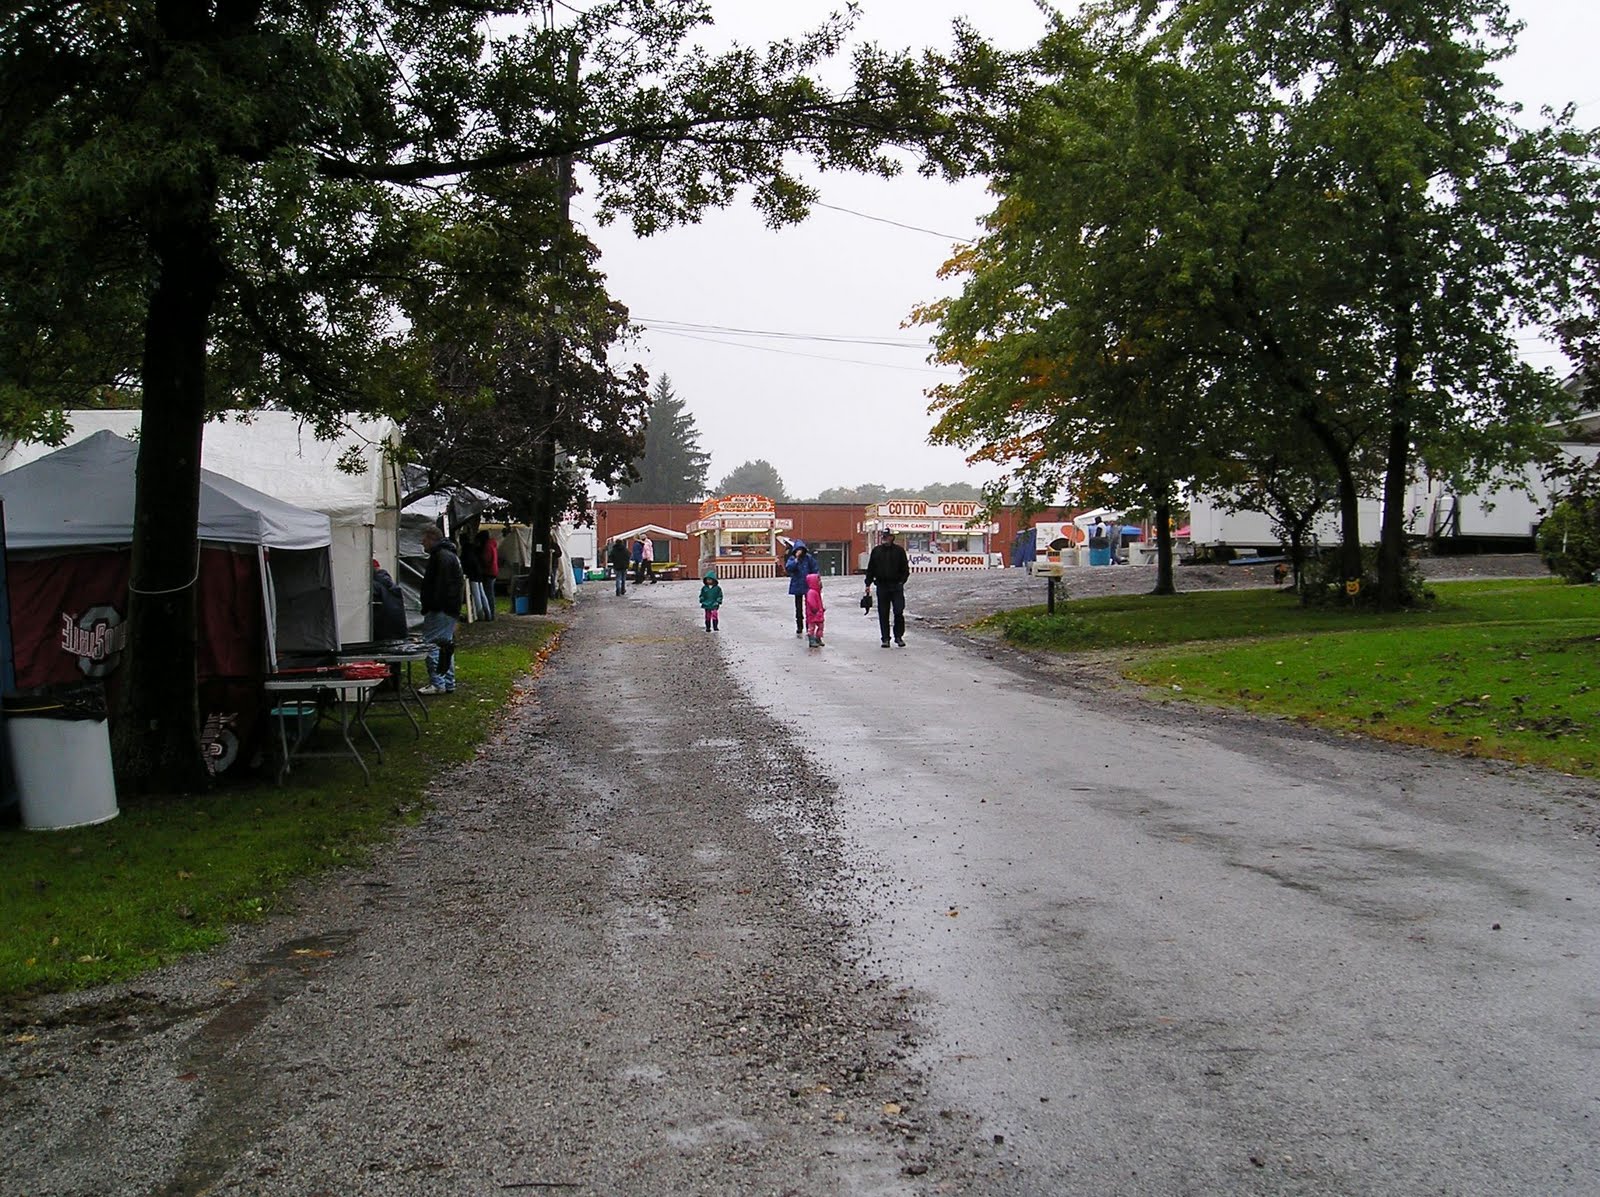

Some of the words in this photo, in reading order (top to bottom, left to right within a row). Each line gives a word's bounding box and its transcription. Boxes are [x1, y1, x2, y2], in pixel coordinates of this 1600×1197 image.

[889, 504, 926, 514] COTTON
[943, 504, 976, 515] CANDY
[938, 556, 984, 565] POPCORN
